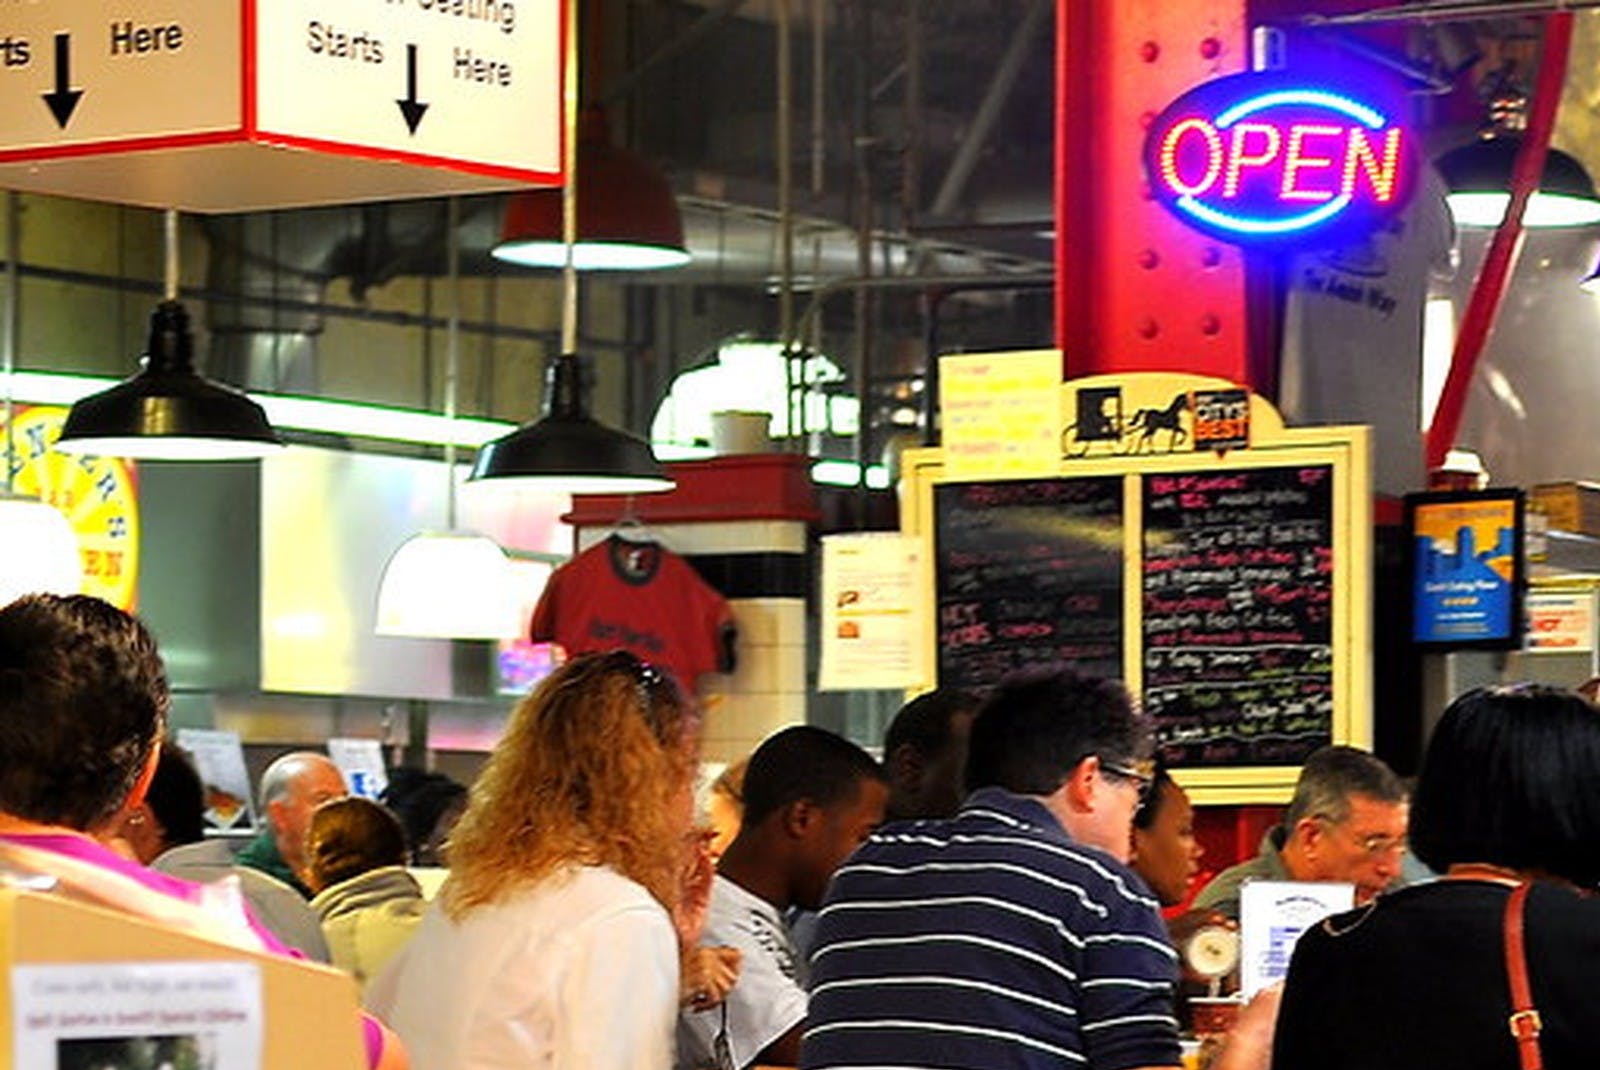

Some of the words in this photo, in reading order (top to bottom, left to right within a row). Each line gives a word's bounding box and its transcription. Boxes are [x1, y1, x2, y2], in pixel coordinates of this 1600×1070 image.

[110, 21, 183, 55] Here
[307, 20, 384, 64] Starts
[453, 46, 511, 86] Here
[1160, 118, 1401, 202] OPEN
